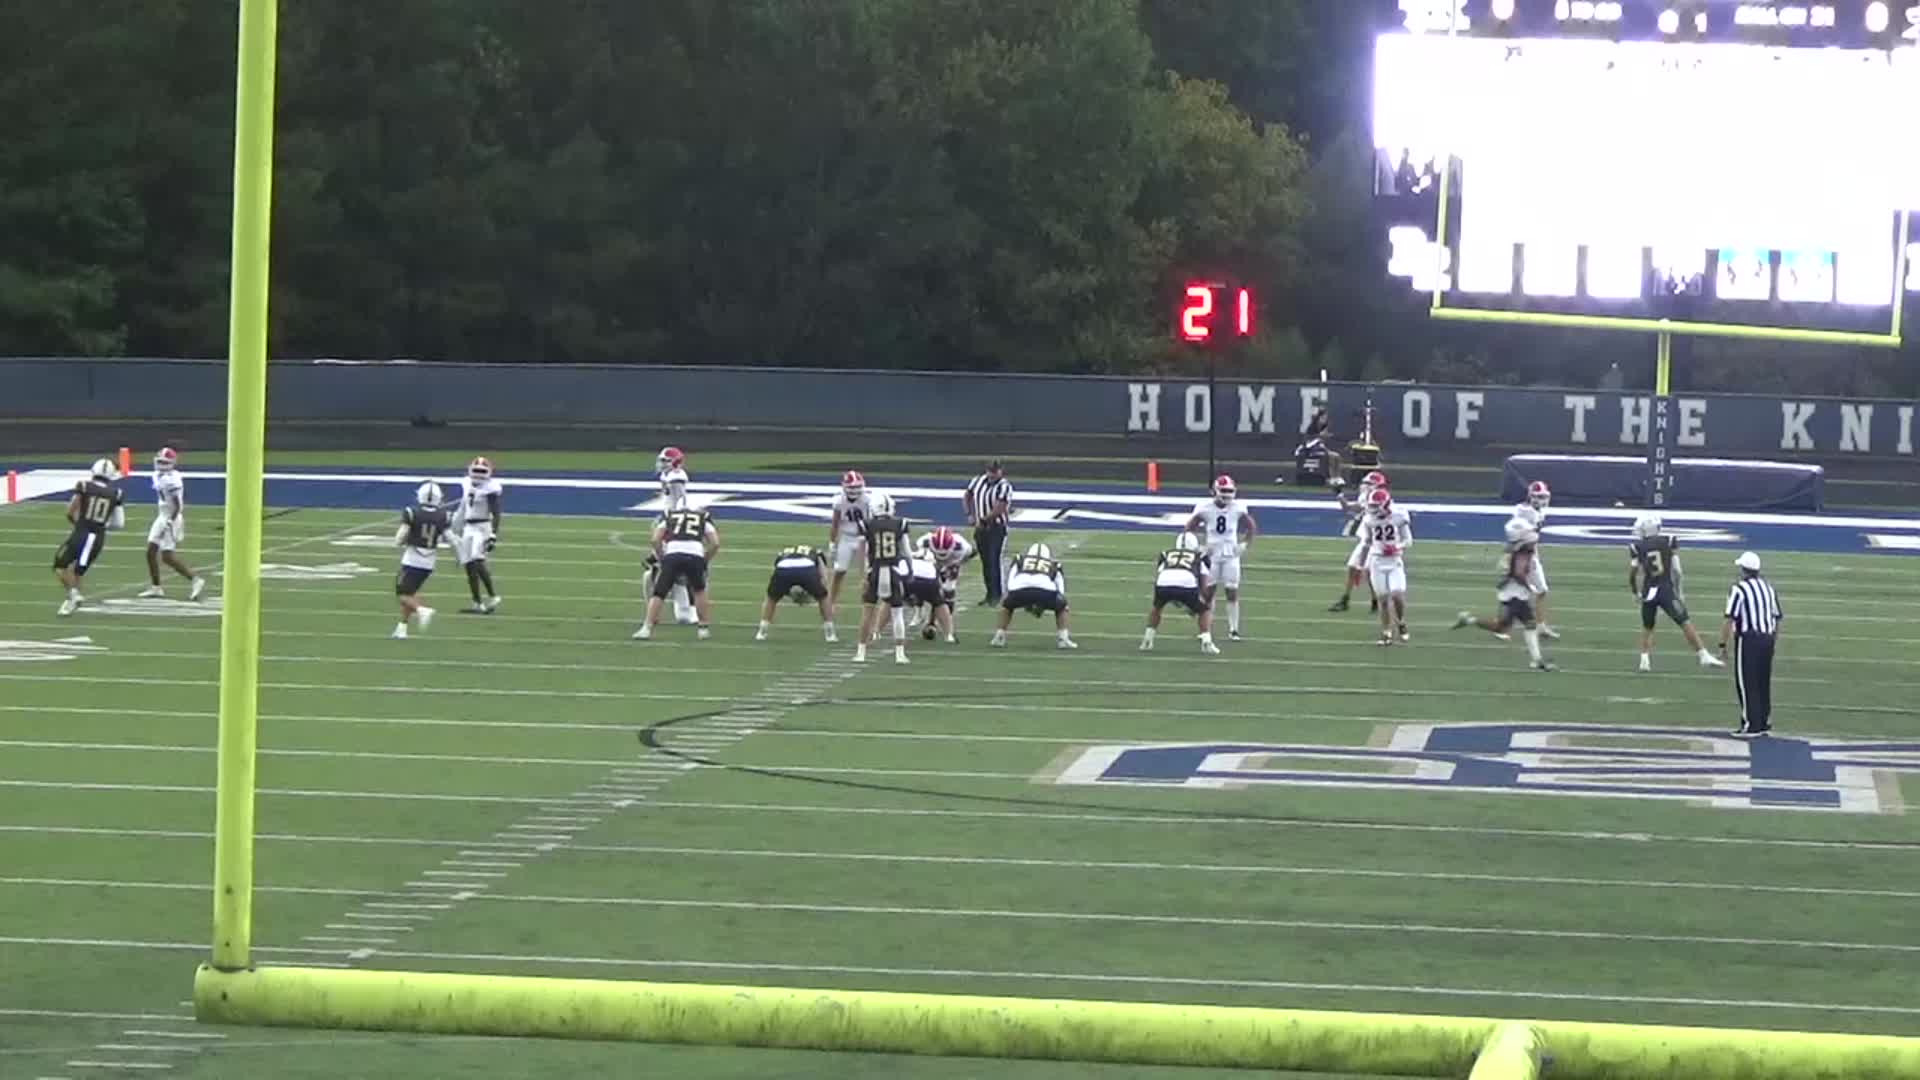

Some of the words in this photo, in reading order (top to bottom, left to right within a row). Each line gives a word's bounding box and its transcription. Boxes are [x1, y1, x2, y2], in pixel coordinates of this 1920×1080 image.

[1183, 287, 1248, 336] 21
[1128, 383, 1328, 433] HOME
[1402, 390, 1484, 438] OF
[1564, 394, 1707, 446] THE
[1780, 402, 1913, 453] KNI
[1654, 401, 1667, 504] KNIGHTS
[85, 495, 111, 523] 10
[421, 523, 436, 549] 4
[670, 512, 701, 536] 72
[1215, 515, 1226, 534] 8
[1373, 524, 1396, 541] 22
[874, 531, 896, 559] 18
[1166, 551, 1195, 569] 52
[1647, 551, 1665, 576] 3
